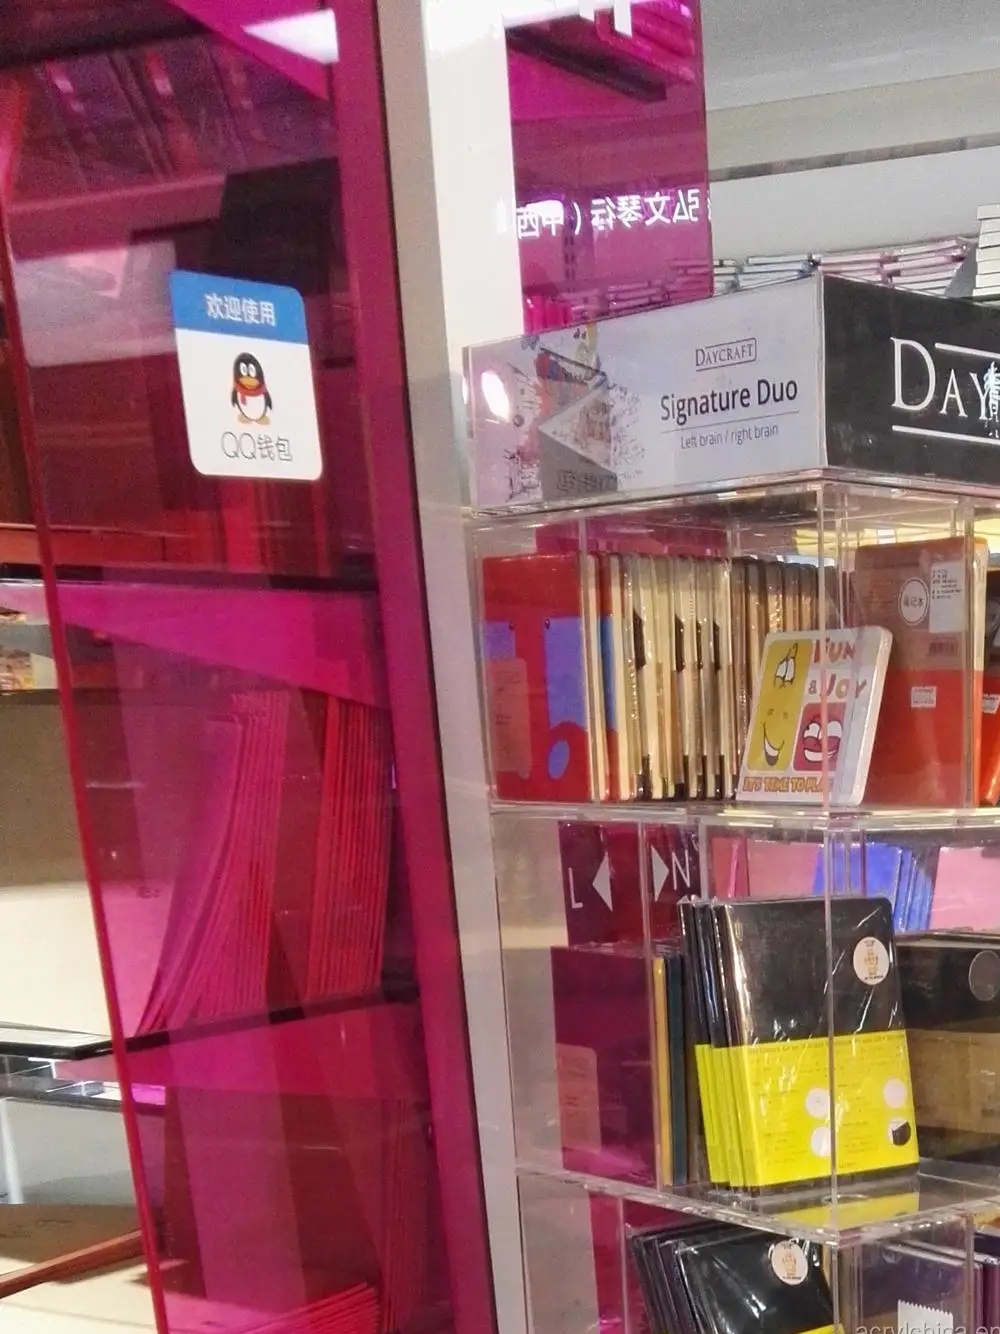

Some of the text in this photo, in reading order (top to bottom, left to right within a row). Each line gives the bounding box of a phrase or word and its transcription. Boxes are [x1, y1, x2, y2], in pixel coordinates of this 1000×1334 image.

[204, 293, 276, 327] 欢迎使用
[695, 343, 753, 367] DAYCRAFT
[660, 379, 798, 426] Signature Duo
[221, 431, 293, 461] QQ钱包
[681, 434, 698, 449] Left
[700, 432, 723, 447] brain
[731, 427, 752, 446] right
[754, 423, 779, 440] brain
